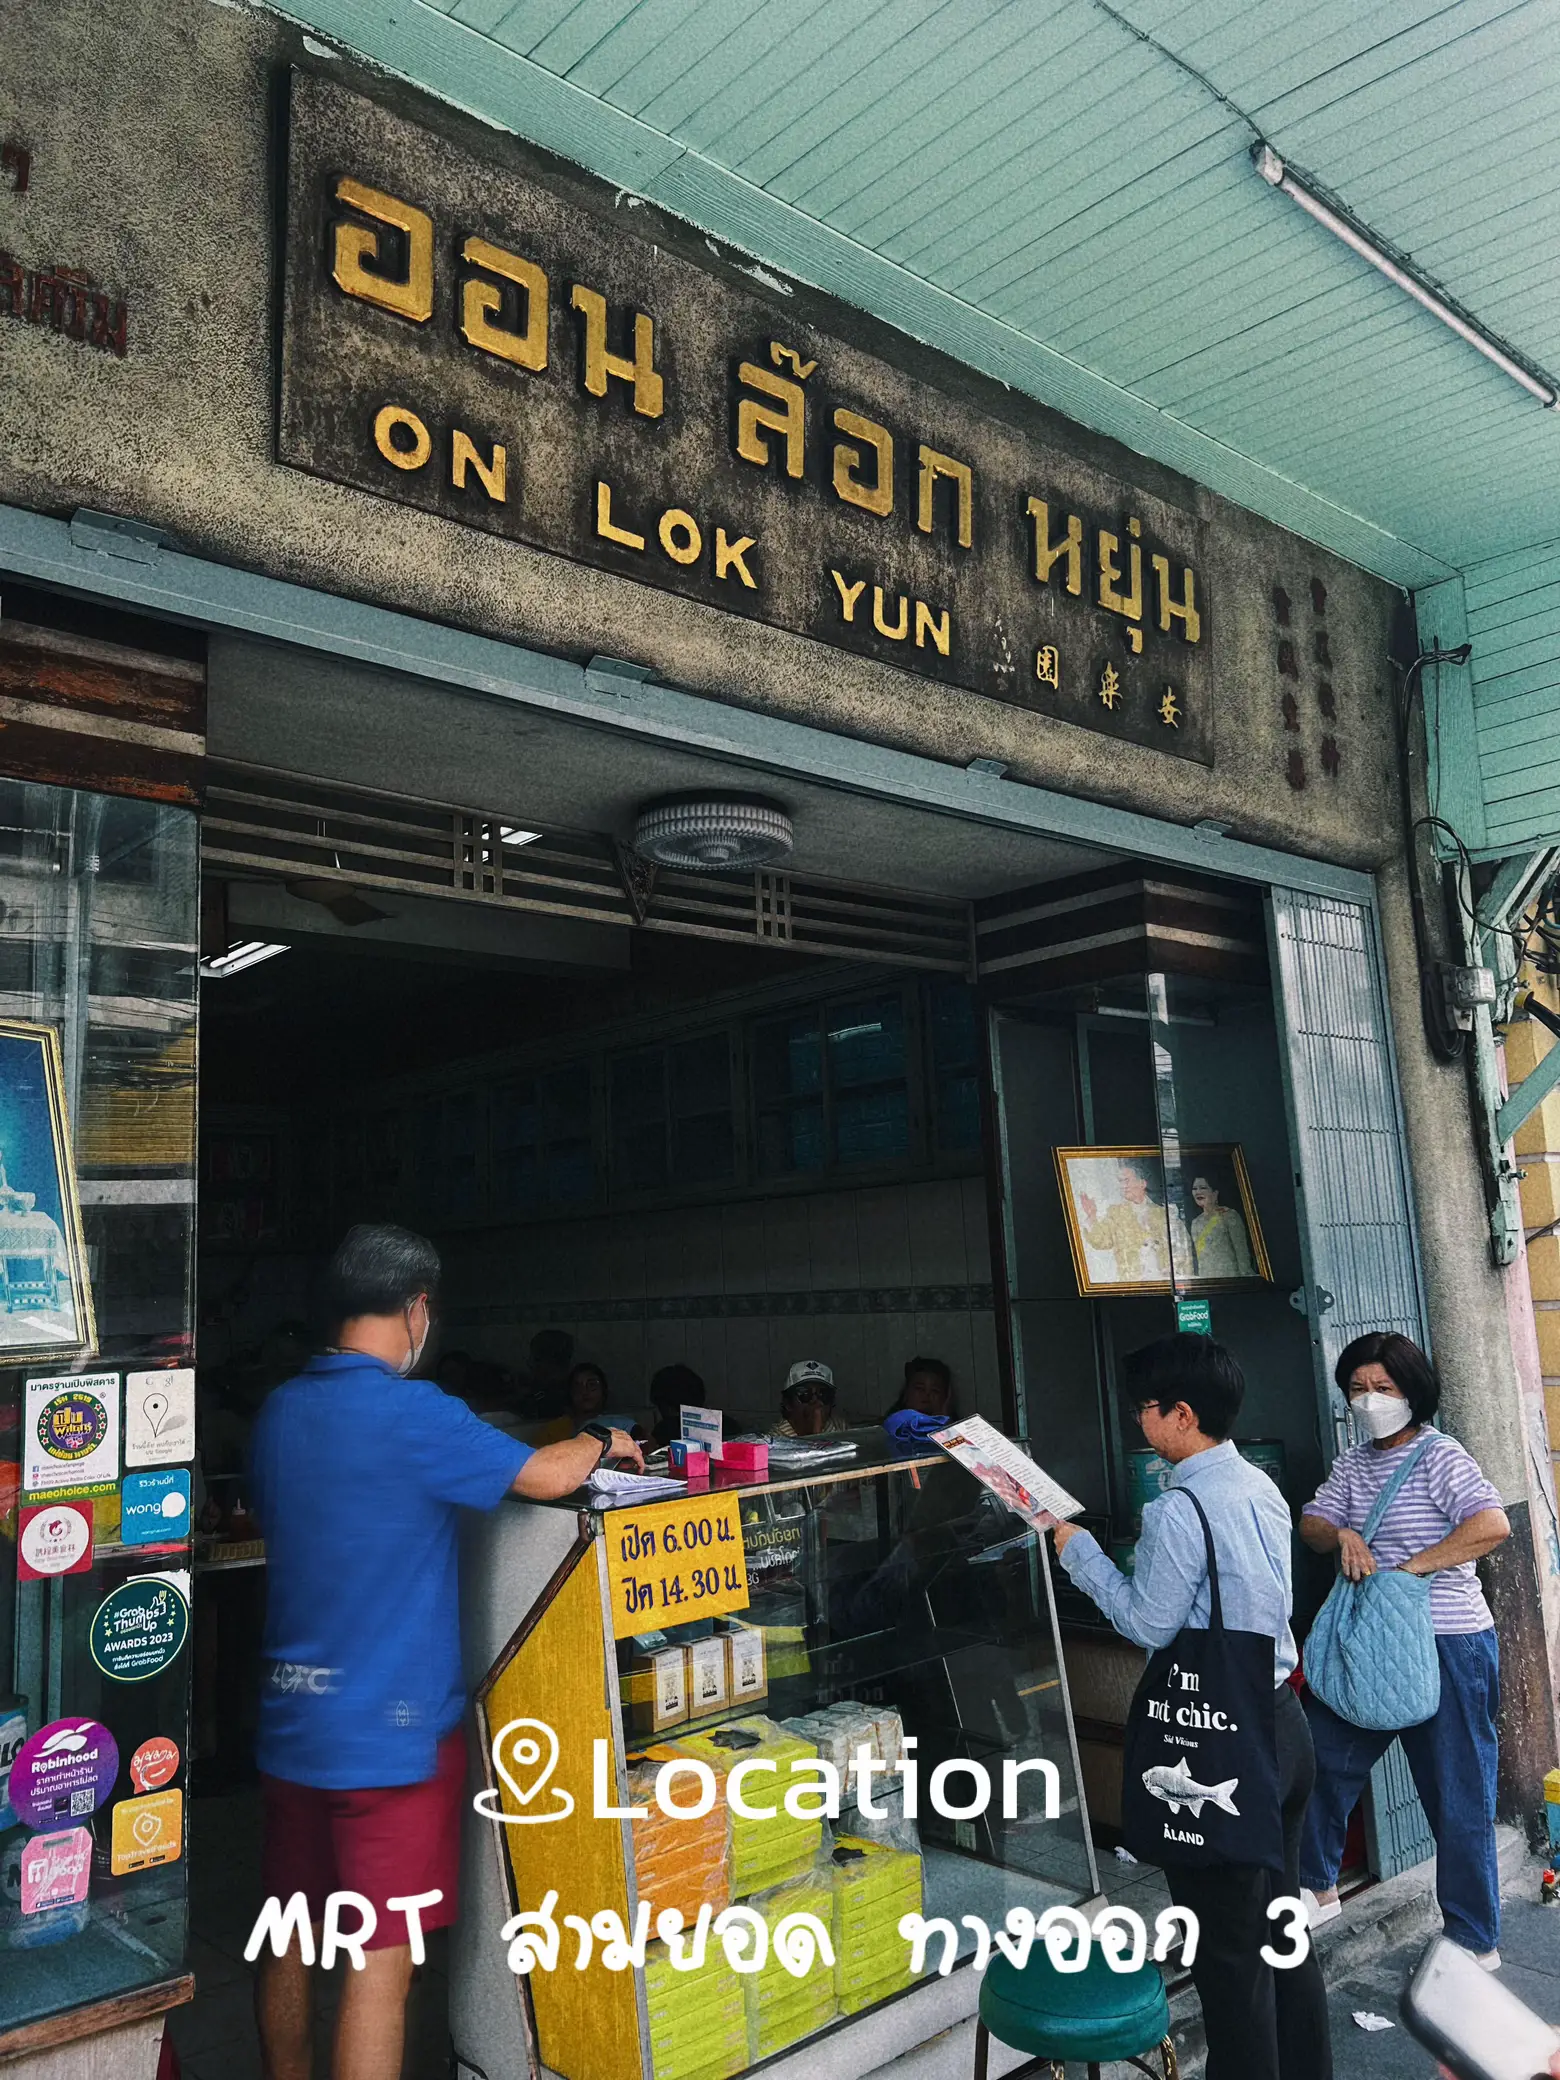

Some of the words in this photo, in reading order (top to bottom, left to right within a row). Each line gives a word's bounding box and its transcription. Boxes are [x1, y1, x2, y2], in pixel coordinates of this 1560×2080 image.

[332, 176, 664, 419] ออน
[1026, 495, 1200, 654] หยุ่น
[374, 405, 506, 503] ON
[597, 481, 758, 589] LOK
[831, 569, 951, 656] YUN
[676, 1448, 682, 1465] 7
[29, 1482, 116, 1500] maechoice.com
[621, 1523, 657, 1562] เปิด
[663, 1518, 713, 1554] 6.00
[716, 1516, 735, 1542] น.
[621, 1576, 654, 1614] ปิด
[724, 1563, 742, 1591] น.
[114, 1608, 159, 1632] Thumbs
[104, 1637, 147, 1653] AWARDS
[149, 1632, 174, 1645] 2023
[131, 1655, 164, 1667] GrabFood
[1176, 1701, 1238, 1732] chic.
[31, 1748, 98, 1774] Robinhood
